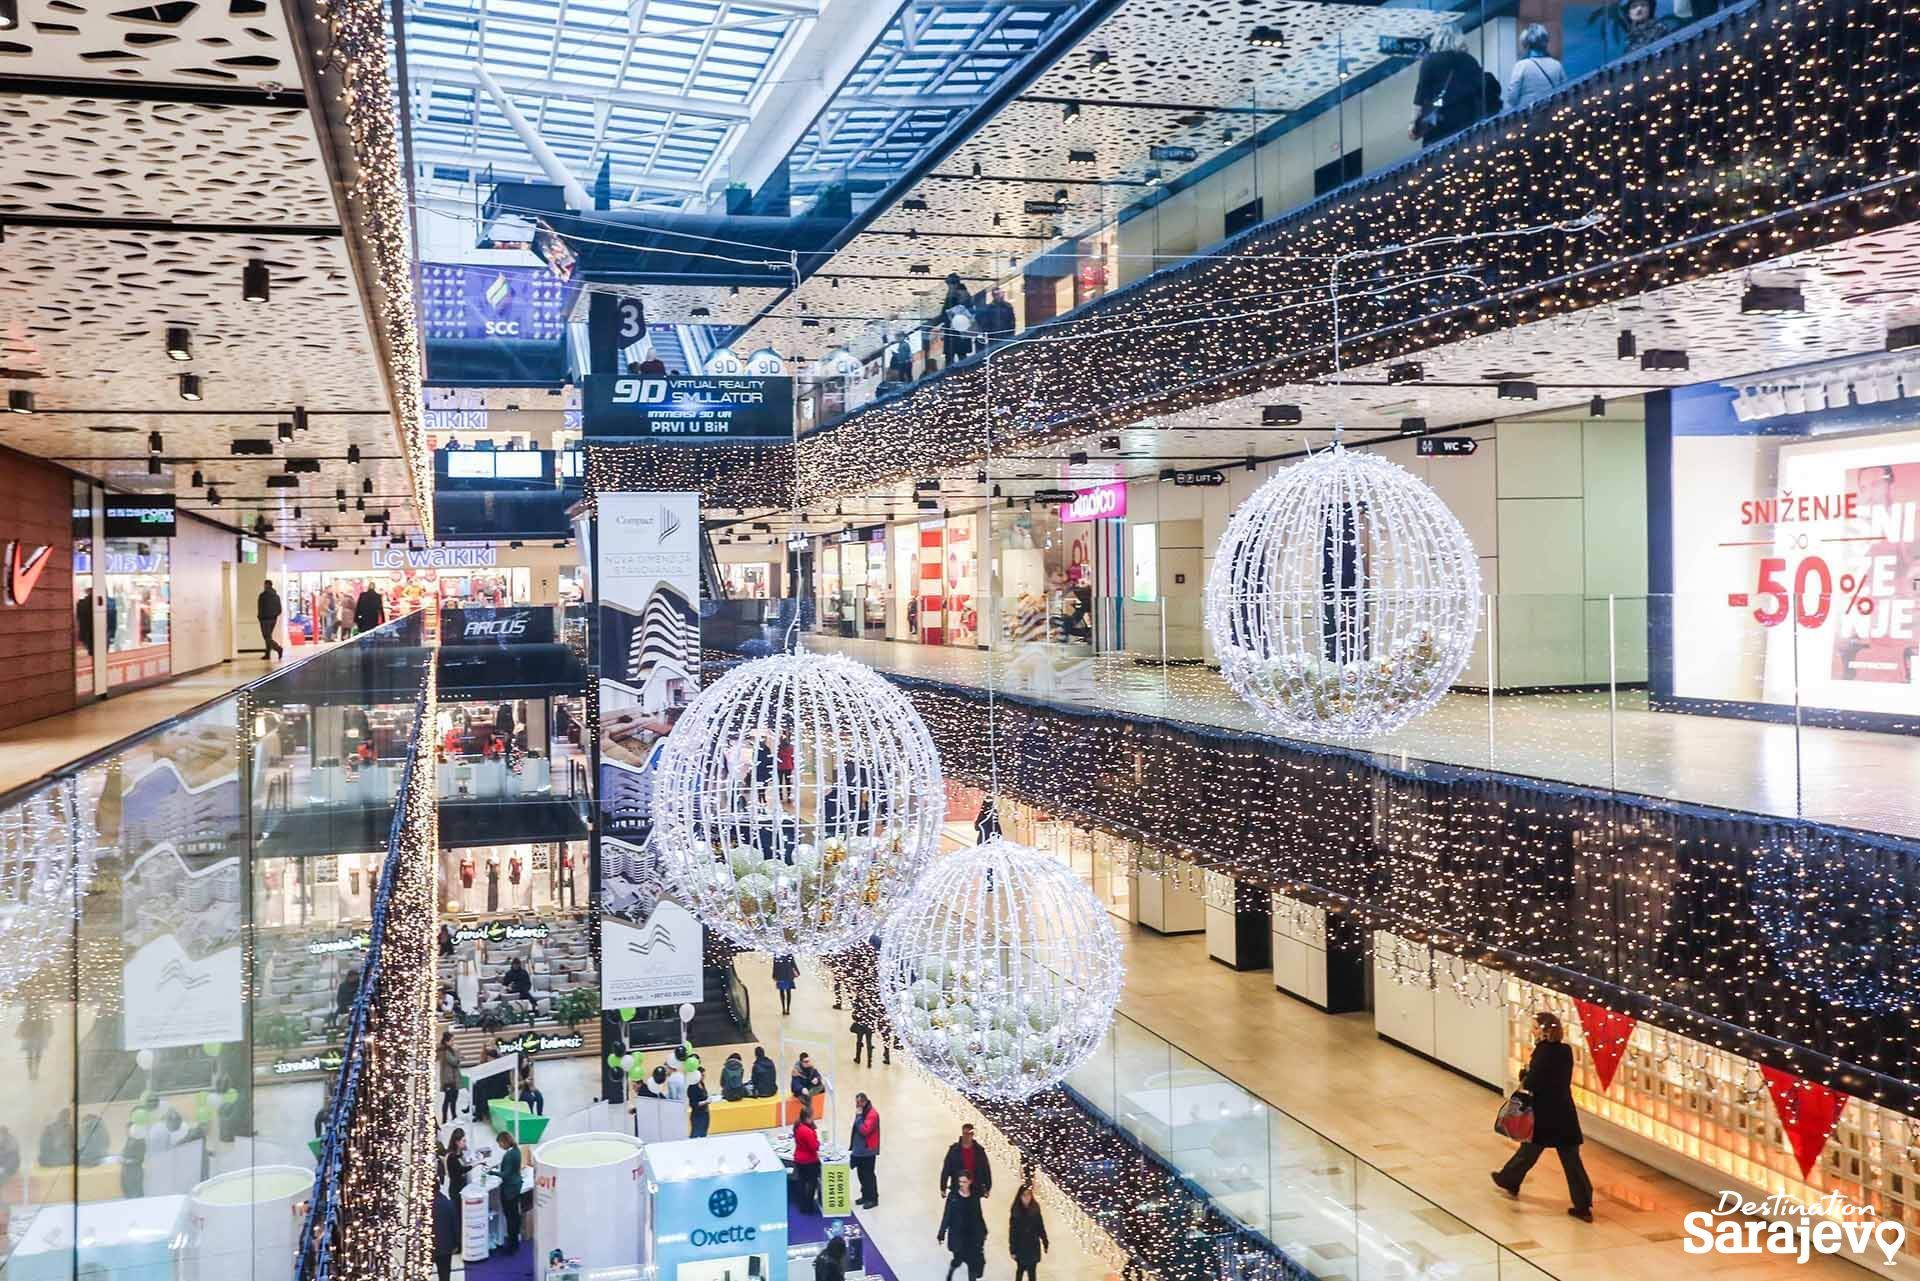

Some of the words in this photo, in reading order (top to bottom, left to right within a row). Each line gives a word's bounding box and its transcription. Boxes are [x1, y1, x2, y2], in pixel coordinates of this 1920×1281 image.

[485, 320, 519, 335] SCC
[620, 304, 640, 338] 3
[612, 379, 668, 404] 9D
[670, 380, 717, 389] VIRTUAL
[718, 380, 766, 389] REALITY
[671, 391, 764, 404] SIMULATOR
[651, 421, 685, 433] PRVI
[689, 421, 700, 433] U
[704, 421, 729, 433] BiH
[1443, 441, 1460, 451] WC
[1741, 489, 1858, 526] SNIŽENJE
[372, 550, 404, 567] LC
[463, 619, 529, 636] ARCUS
[690, 1225, 757, 1247] Oxette
